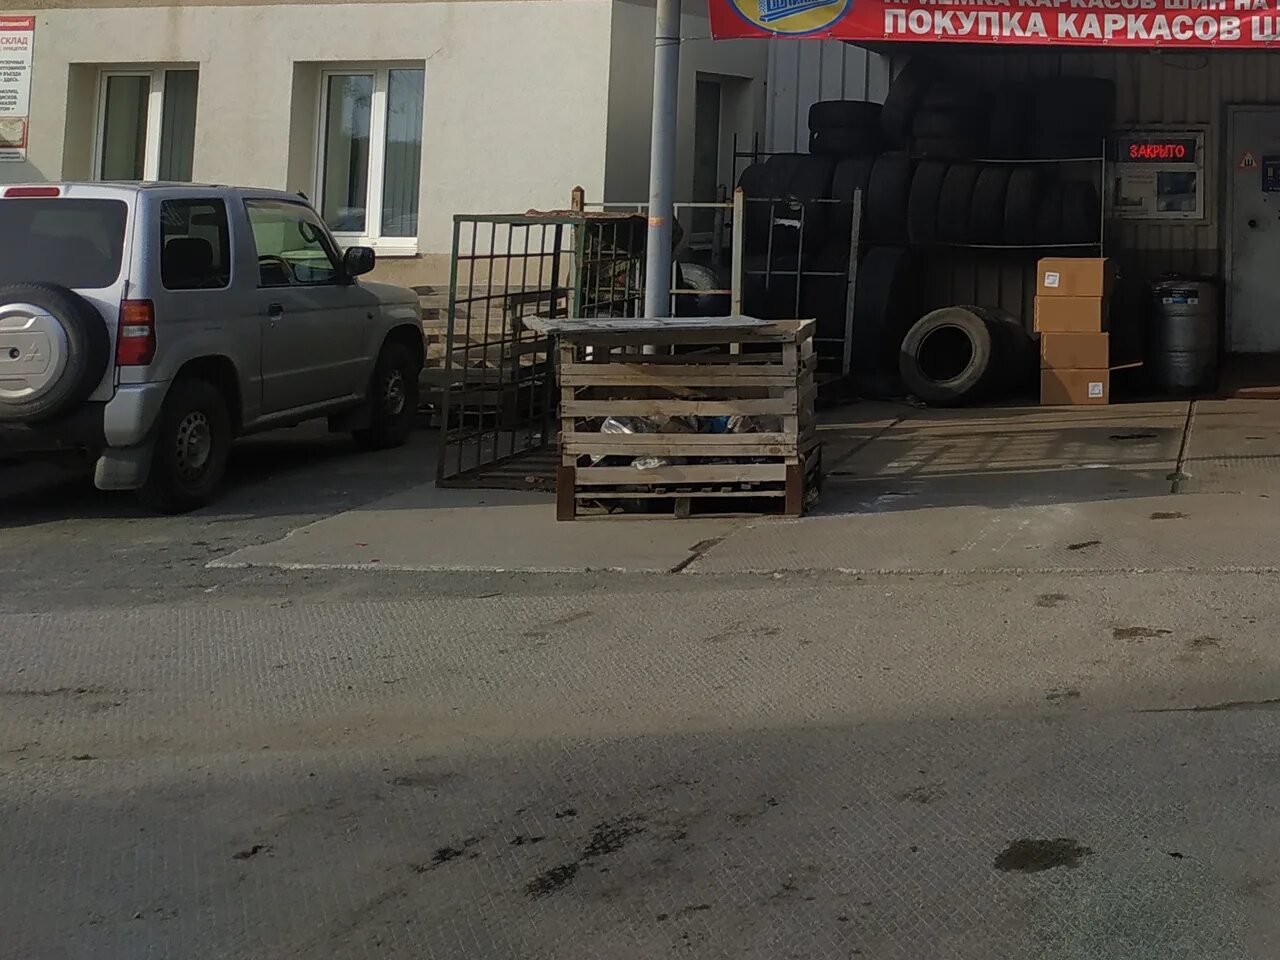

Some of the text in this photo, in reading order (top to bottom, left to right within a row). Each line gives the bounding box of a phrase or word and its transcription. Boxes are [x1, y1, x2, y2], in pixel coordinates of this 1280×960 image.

[884, 9, 1047, 37] ПОКУПКА
[1057, 13, 1241, 41] КАРКАСОВ
[1129, 144, 1185, 158] ЗАКРЫТО
